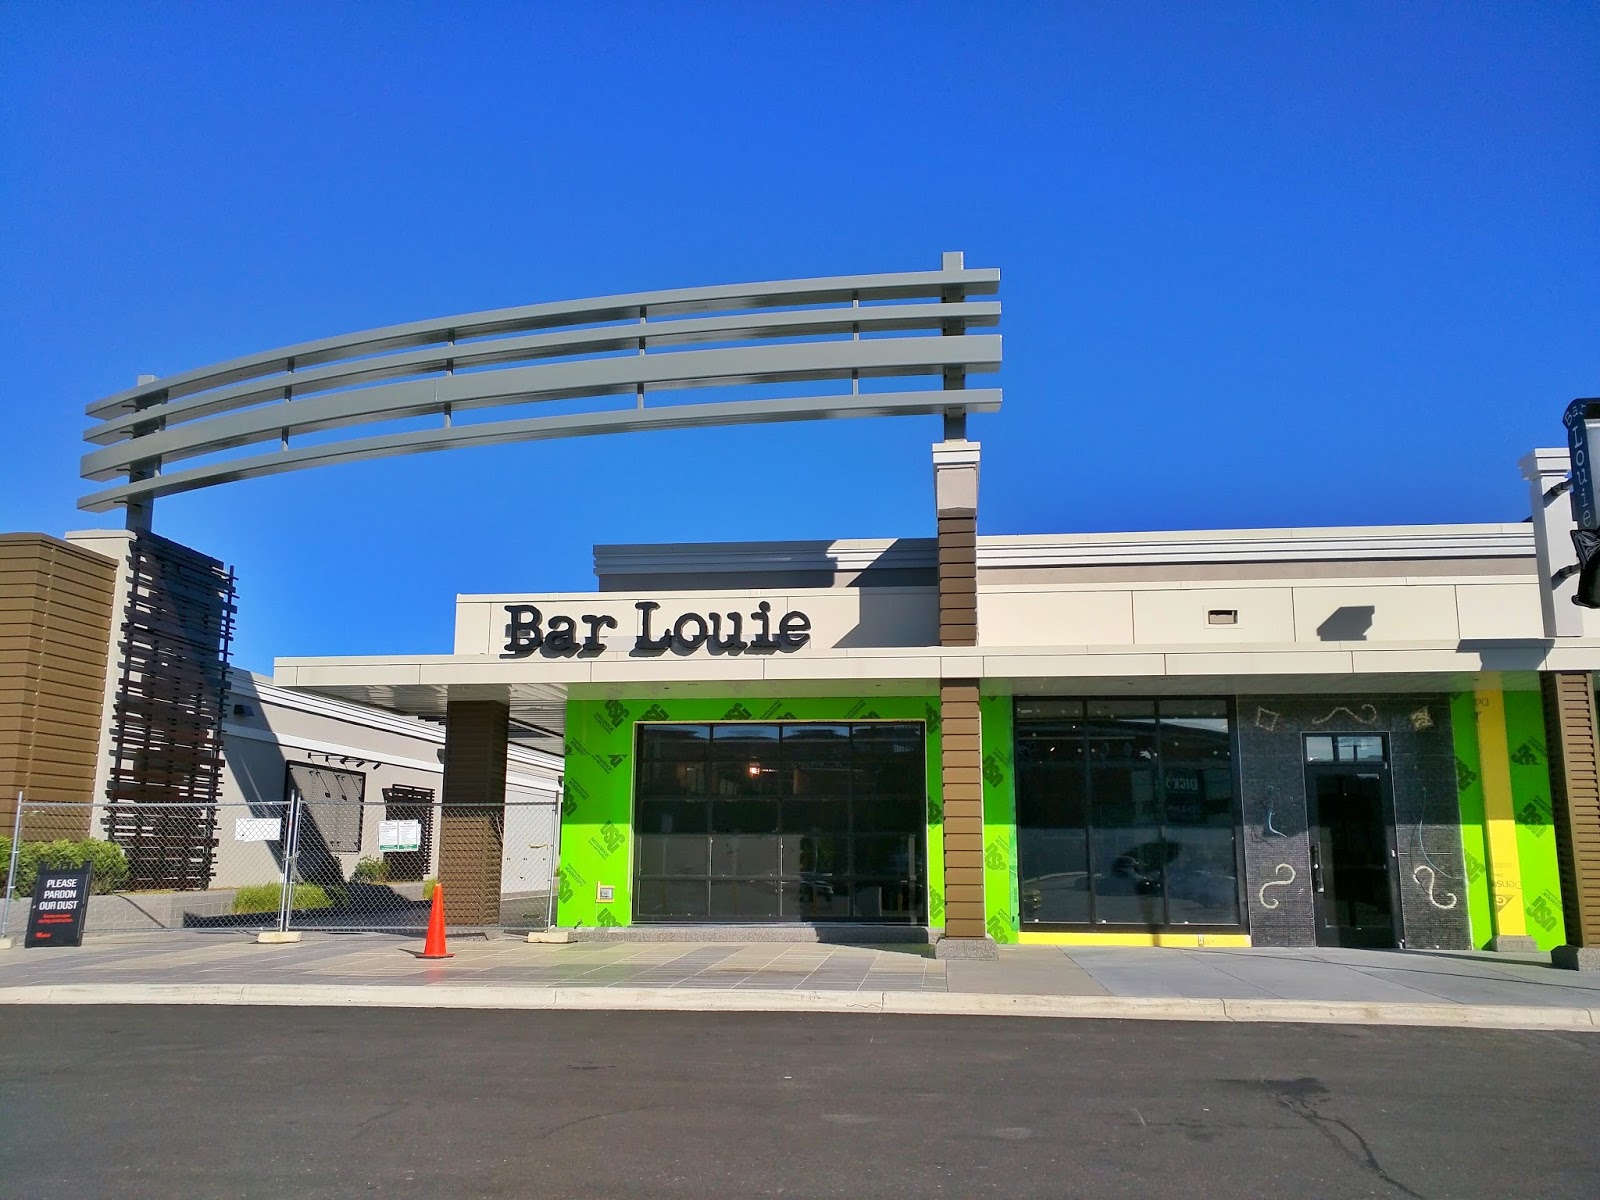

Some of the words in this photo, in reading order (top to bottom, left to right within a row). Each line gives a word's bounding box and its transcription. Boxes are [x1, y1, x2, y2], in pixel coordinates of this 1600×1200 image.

[1564, 403, 1587, 425] Bar
[1573, 426, 1592, 527] Louie
[503, 604, 618, 653] Bar
[634, 601, 812, 652] Louie
[600, 820, 626, 853] USG
[44, 890, 77, 899] PARDON
[46, 879, 78, 888] PLEASE
[39, 901, 56, 910] OUR
[57, 901, 79, 910] DUST
[1527, 895, 1558, 933] USG
